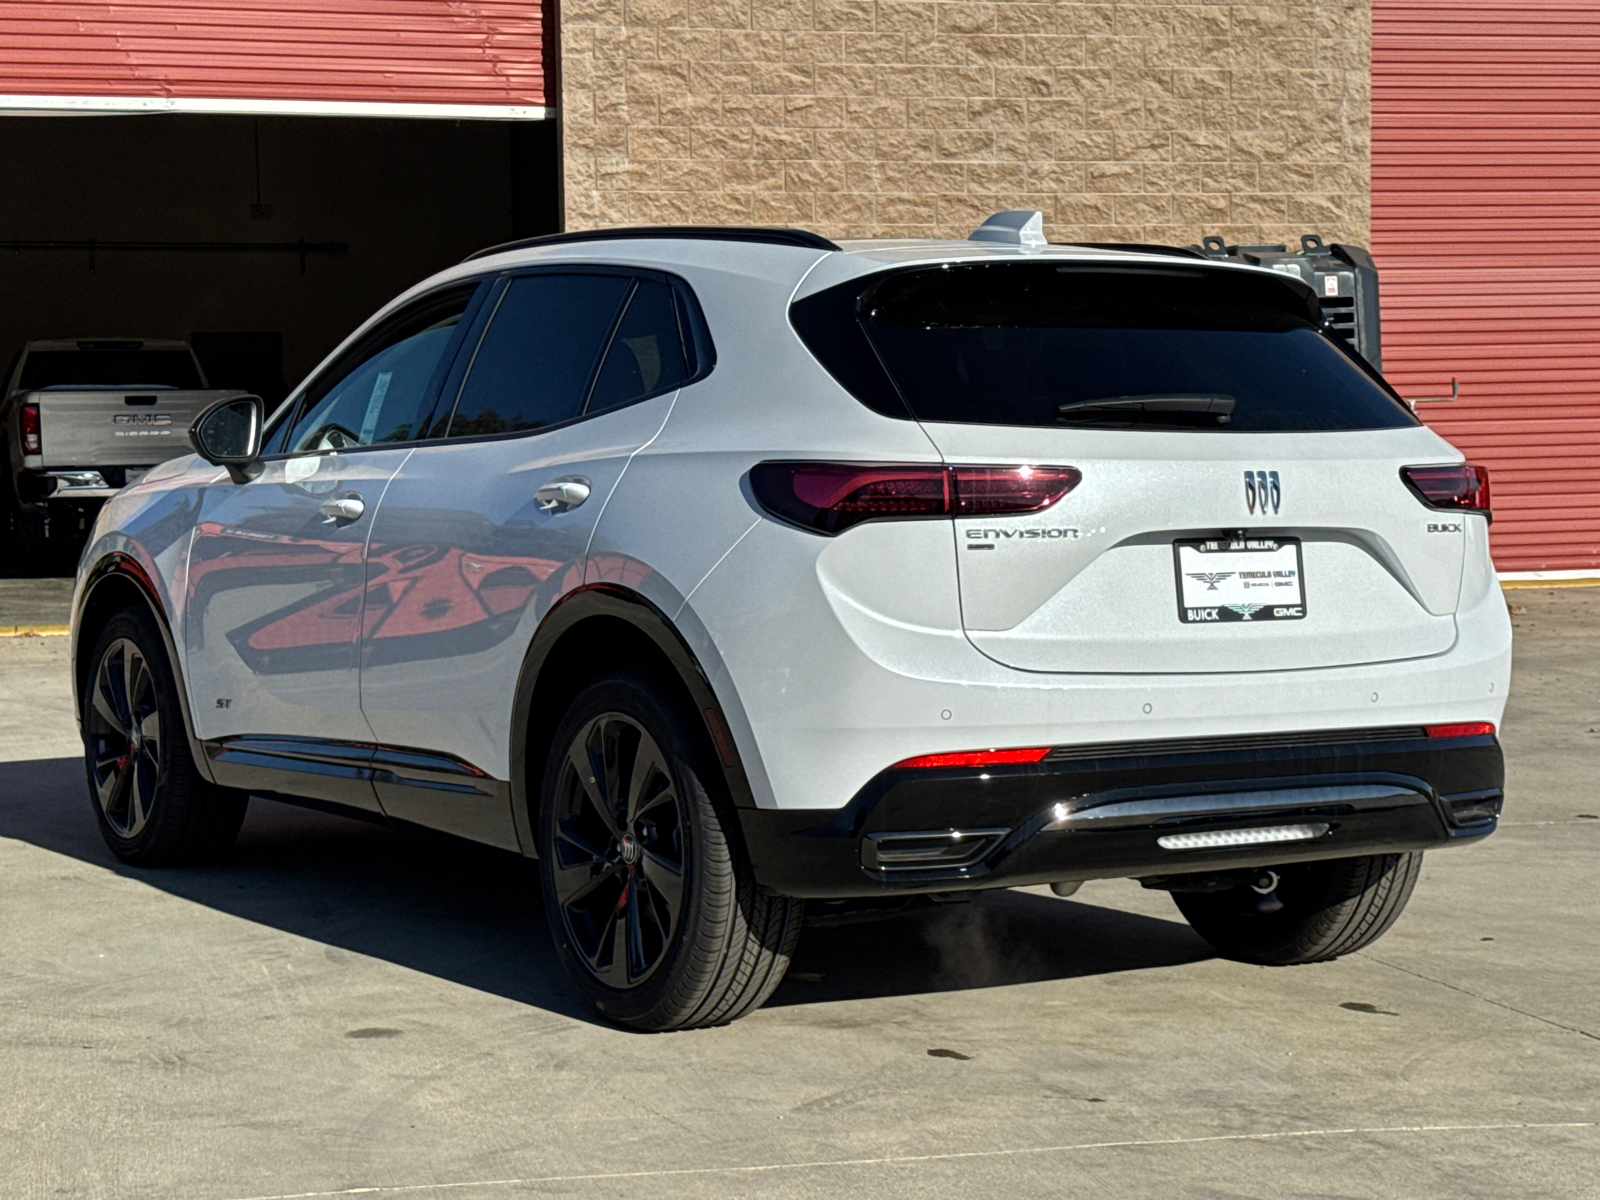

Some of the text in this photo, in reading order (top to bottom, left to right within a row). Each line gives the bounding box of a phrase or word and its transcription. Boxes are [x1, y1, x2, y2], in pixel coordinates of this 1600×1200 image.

[113, 414, 172, 425] GMC
[1427, 523, 1462, 533] BUICK
[966, 528, 1078, 539] ENVISION
[1238, 570, 1296, 579] TEMECULA VALLEY
[1187, 607, 1303, 620] BUICK GMC
[215, 698, 232, 708] ST
